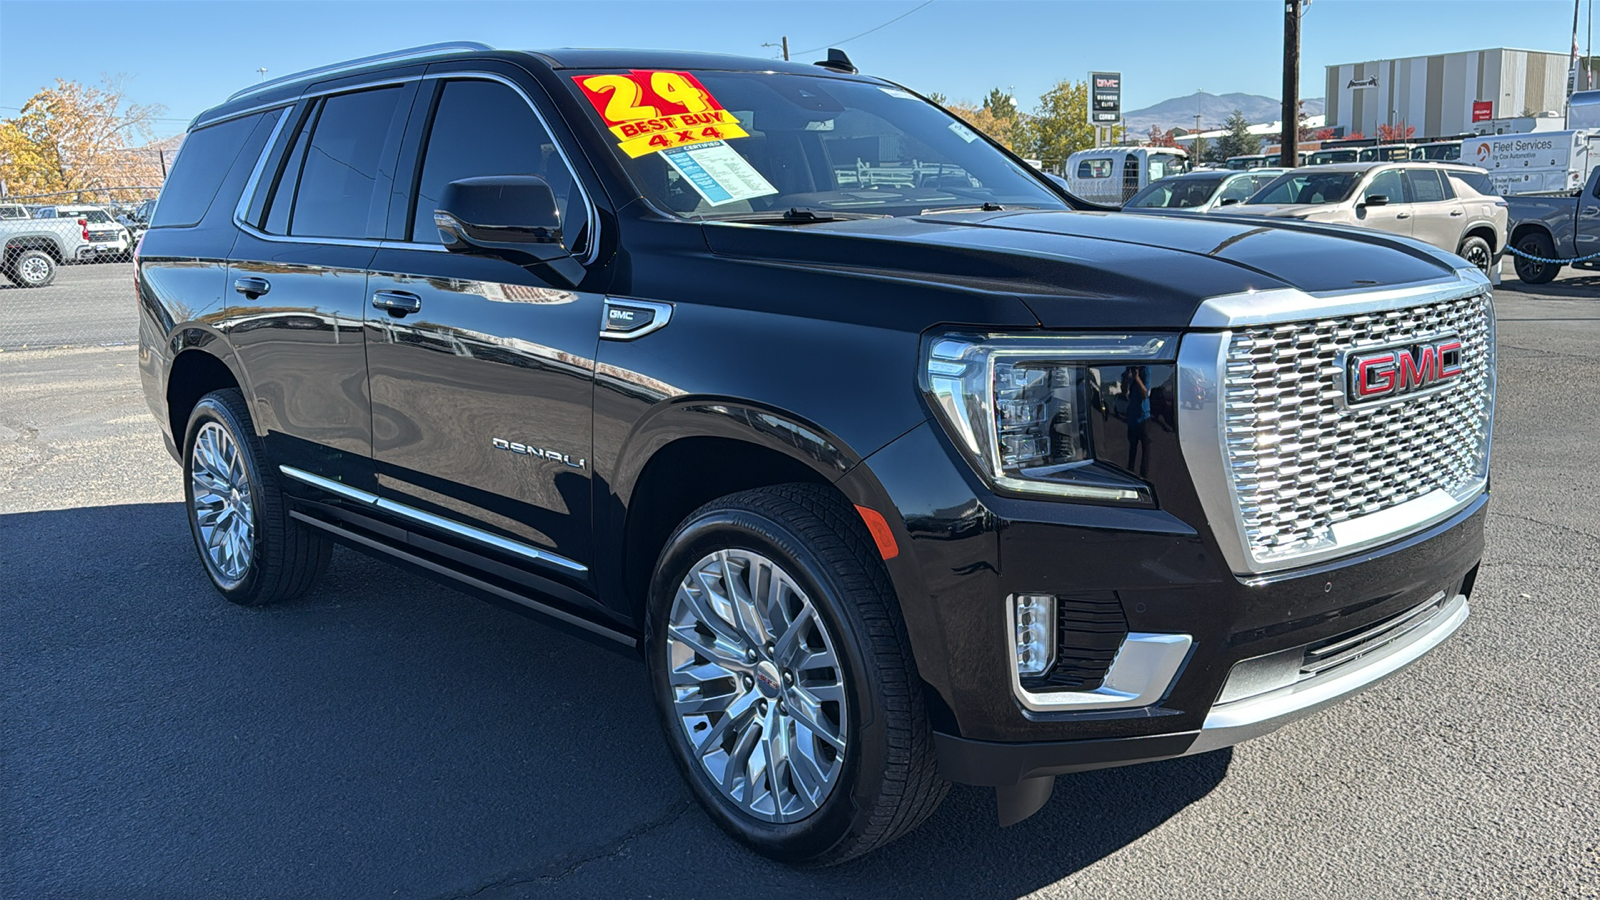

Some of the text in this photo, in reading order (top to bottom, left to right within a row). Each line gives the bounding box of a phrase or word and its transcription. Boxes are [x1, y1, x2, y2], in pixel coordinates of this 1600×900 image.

[1096, 78, 1118, 88] GMC
[582, 71, 710, 122] 24
[619, 111, 723, 139] BEST BUY
[683, 140, 721, 151] CERTIFIED
[1493, 139, 1552, 152] Fleet Services
[609, 309, 634, 320] GMC
[1355, 341, 1462, 398] GMC
[492, 437, 586, 470] DENALI
